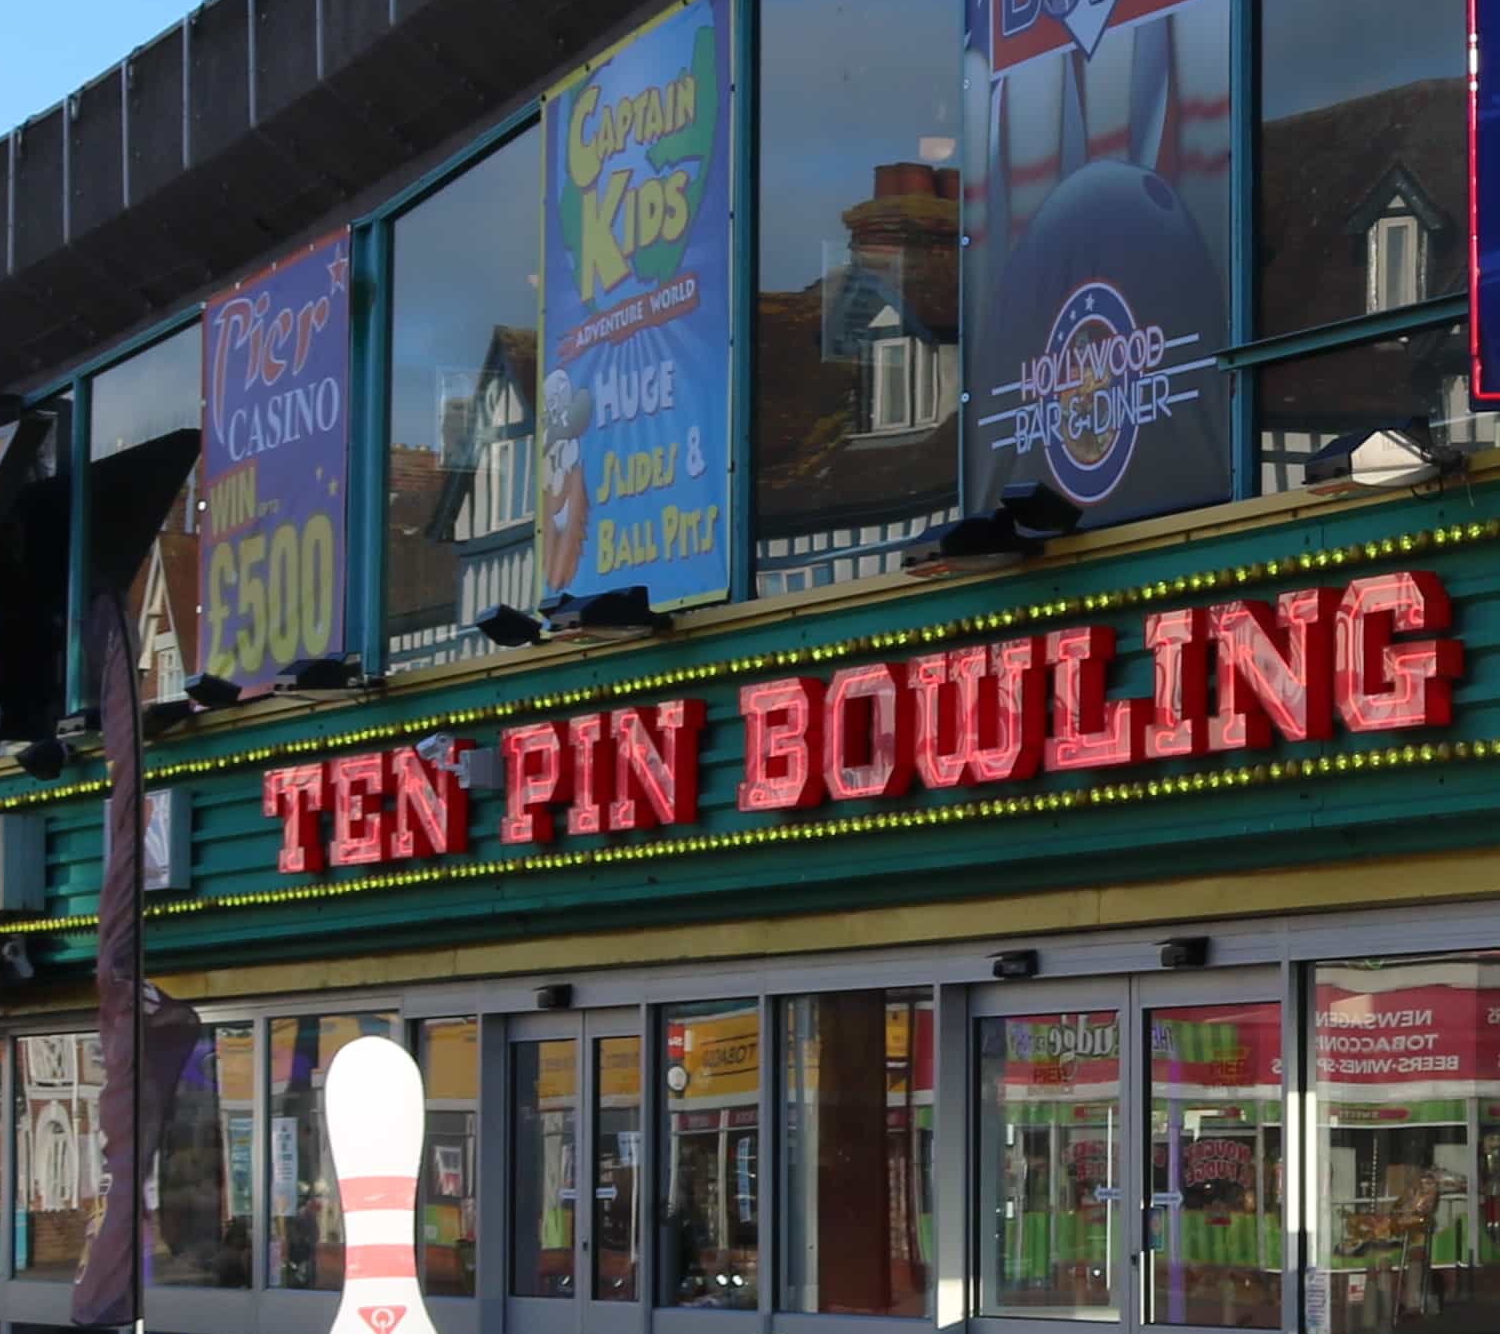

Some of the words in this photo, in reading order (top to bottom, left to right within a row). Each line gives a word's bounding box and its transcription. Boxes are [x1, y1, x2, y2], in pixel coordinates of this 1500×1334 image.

[568, 77, 696, 187] CAPTAIN
[581, 169, 689, 303] KIDS
[575, 303, 643, 349] ADVENTURE
[650, 278, 696, 314] WORLD
[213, 288, 331, 444] Pier
[595, 360, 674, 428] HUGE
[1020, 324, 1164, 403] HOLLYWOOD
[228, 375, 340, 462] CASINO
[1012, 398, 1063, 455] BAR
[1094, 373, 1172, 433] DINER
[210, 472, 257, 535] WIN
[596, 443, 678, 503] SLIDES
[685, 427, 704, 476] &
[596, 515, 658, 576] BALL
[662, 504, 718, 562] PITS
[207, 513, 334, 678] £500
[263, 739, 477, 874] TEN
[502, 698, 706, 846] PIN
[736, 569, 1465, 813] BOWLING
